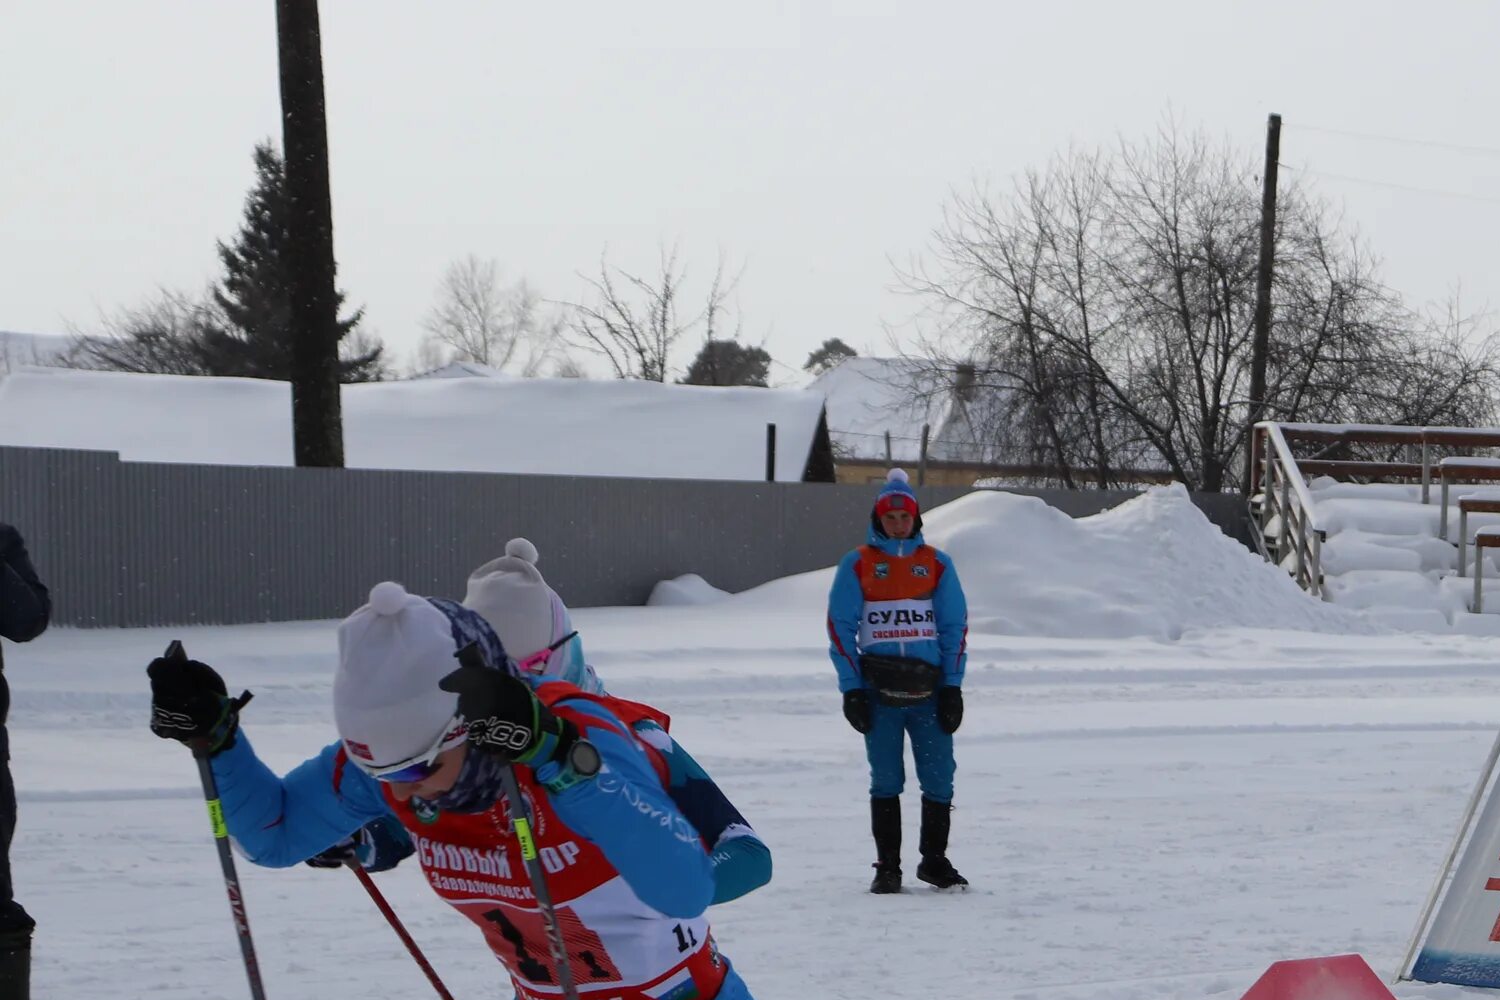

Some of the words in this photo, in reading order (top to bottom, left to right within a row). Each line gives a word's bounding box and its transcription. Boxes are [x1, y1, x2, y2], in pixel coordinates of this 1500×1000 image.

[868, 609, 933, 625] СУДЬЯ
[522, 841, 580, 879] ОР
[482, 908, 553, 982] 1
[579, 950, 611, 978] 1
